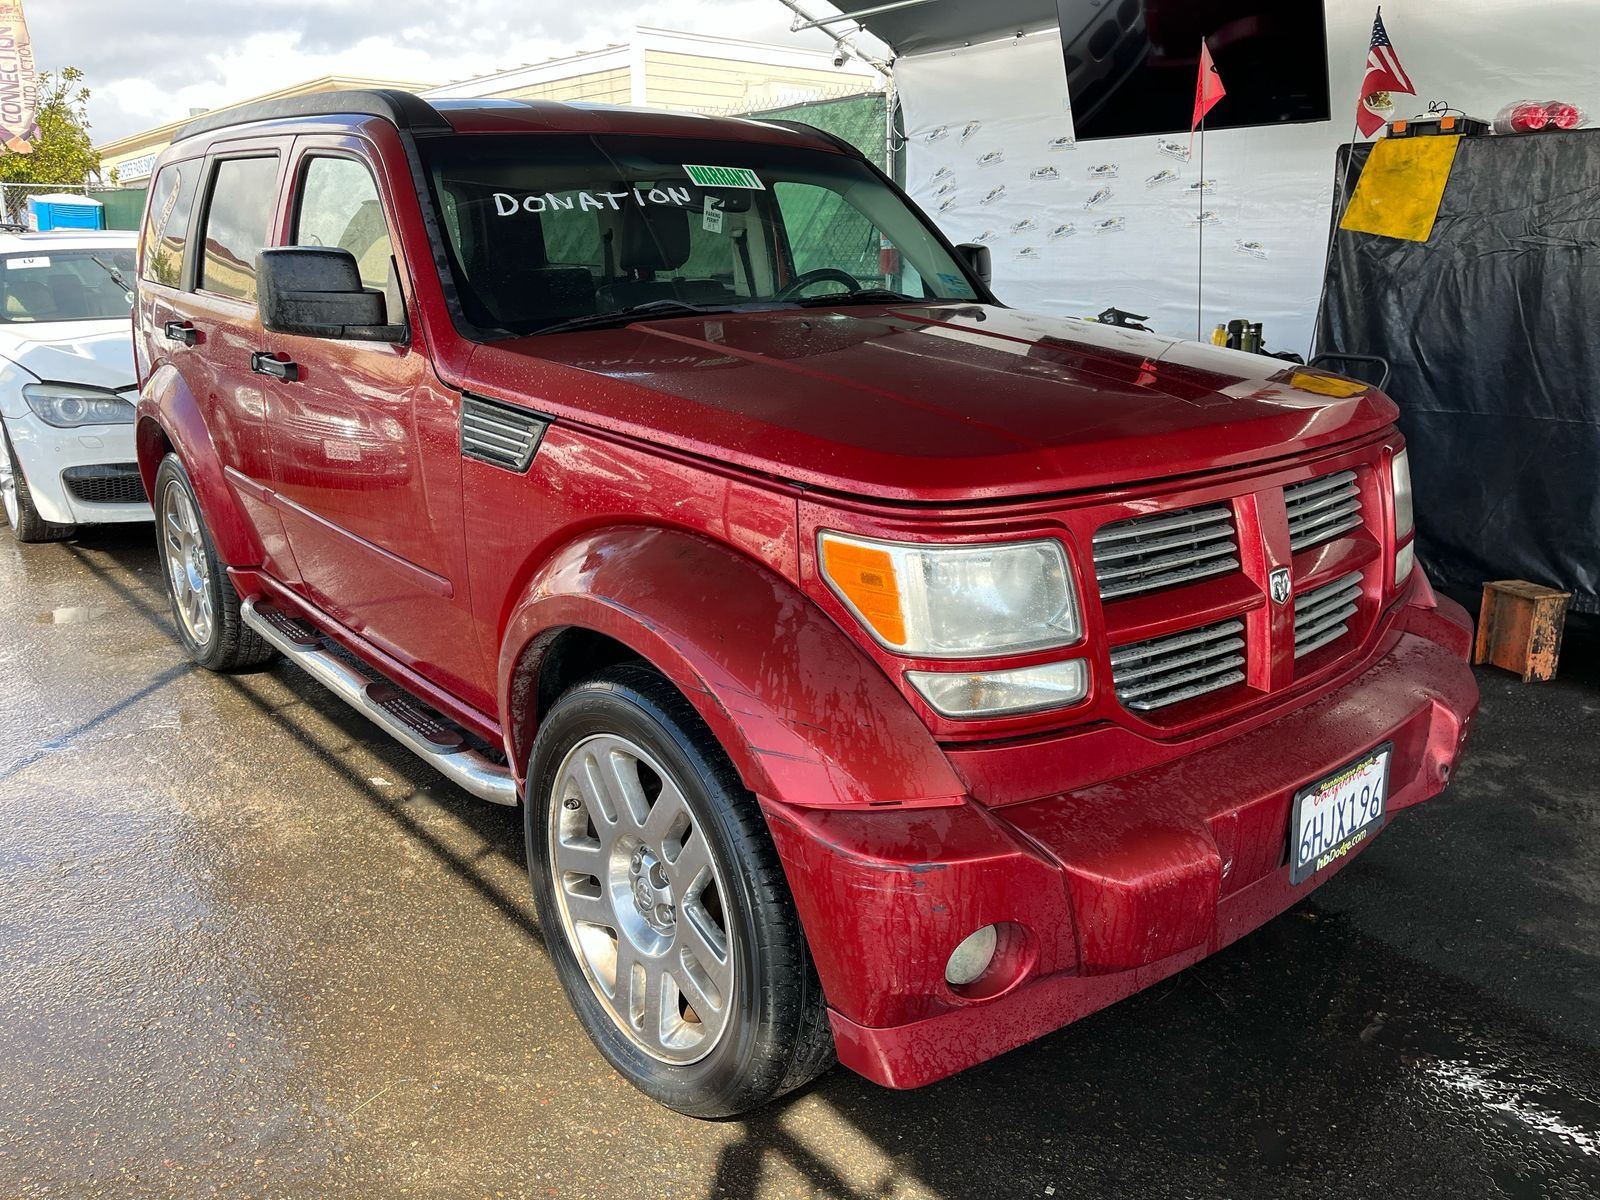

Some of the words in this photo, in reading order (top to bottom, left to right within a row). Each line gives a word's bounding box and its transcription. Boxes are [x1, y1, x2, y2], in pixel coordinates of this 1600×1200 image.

[18, 42, 36, 82] AUCTION
[23, 85, 37, 112] AUTO
[686, 165, 761, 188] WARRANTY
[493, 186, 691, 216] DONATION
[1299, 777, 1382, 865] 6HJX196
[1316, 829, 1368, 871] hbDodge.com
